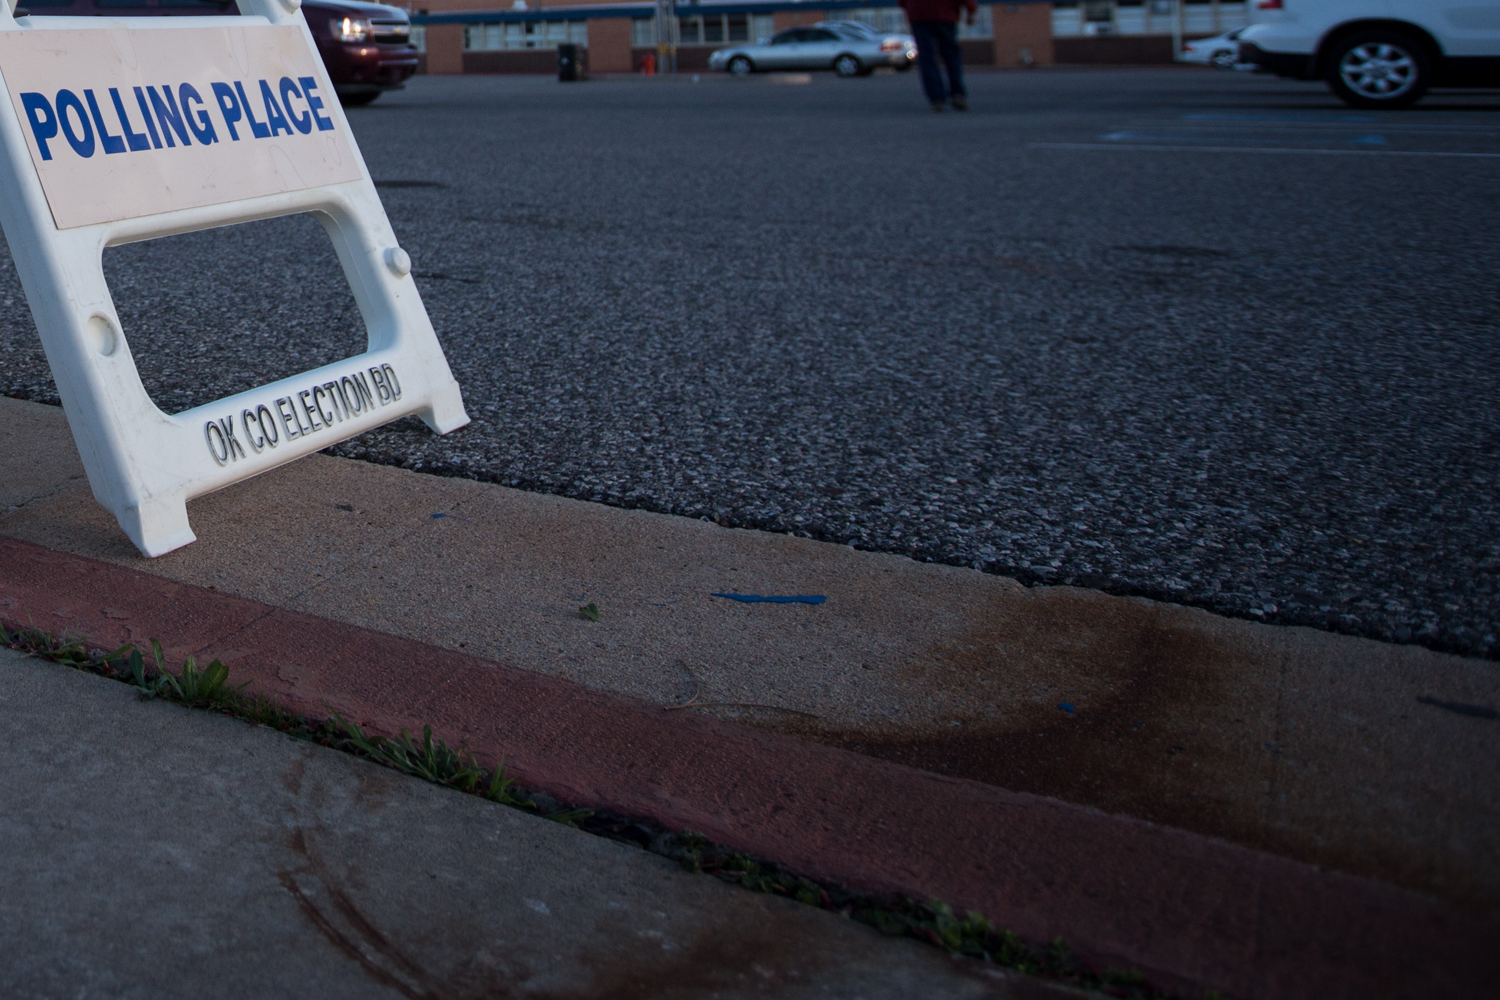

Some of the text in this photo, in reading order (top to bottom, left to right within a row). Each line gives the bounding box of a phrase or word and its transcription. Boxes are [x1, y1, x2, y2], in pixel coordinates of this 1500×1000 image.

[20, 77, 335, 161] POLLING PLACE
[204, 363, 402, 467] OK CO ELECTION BD
